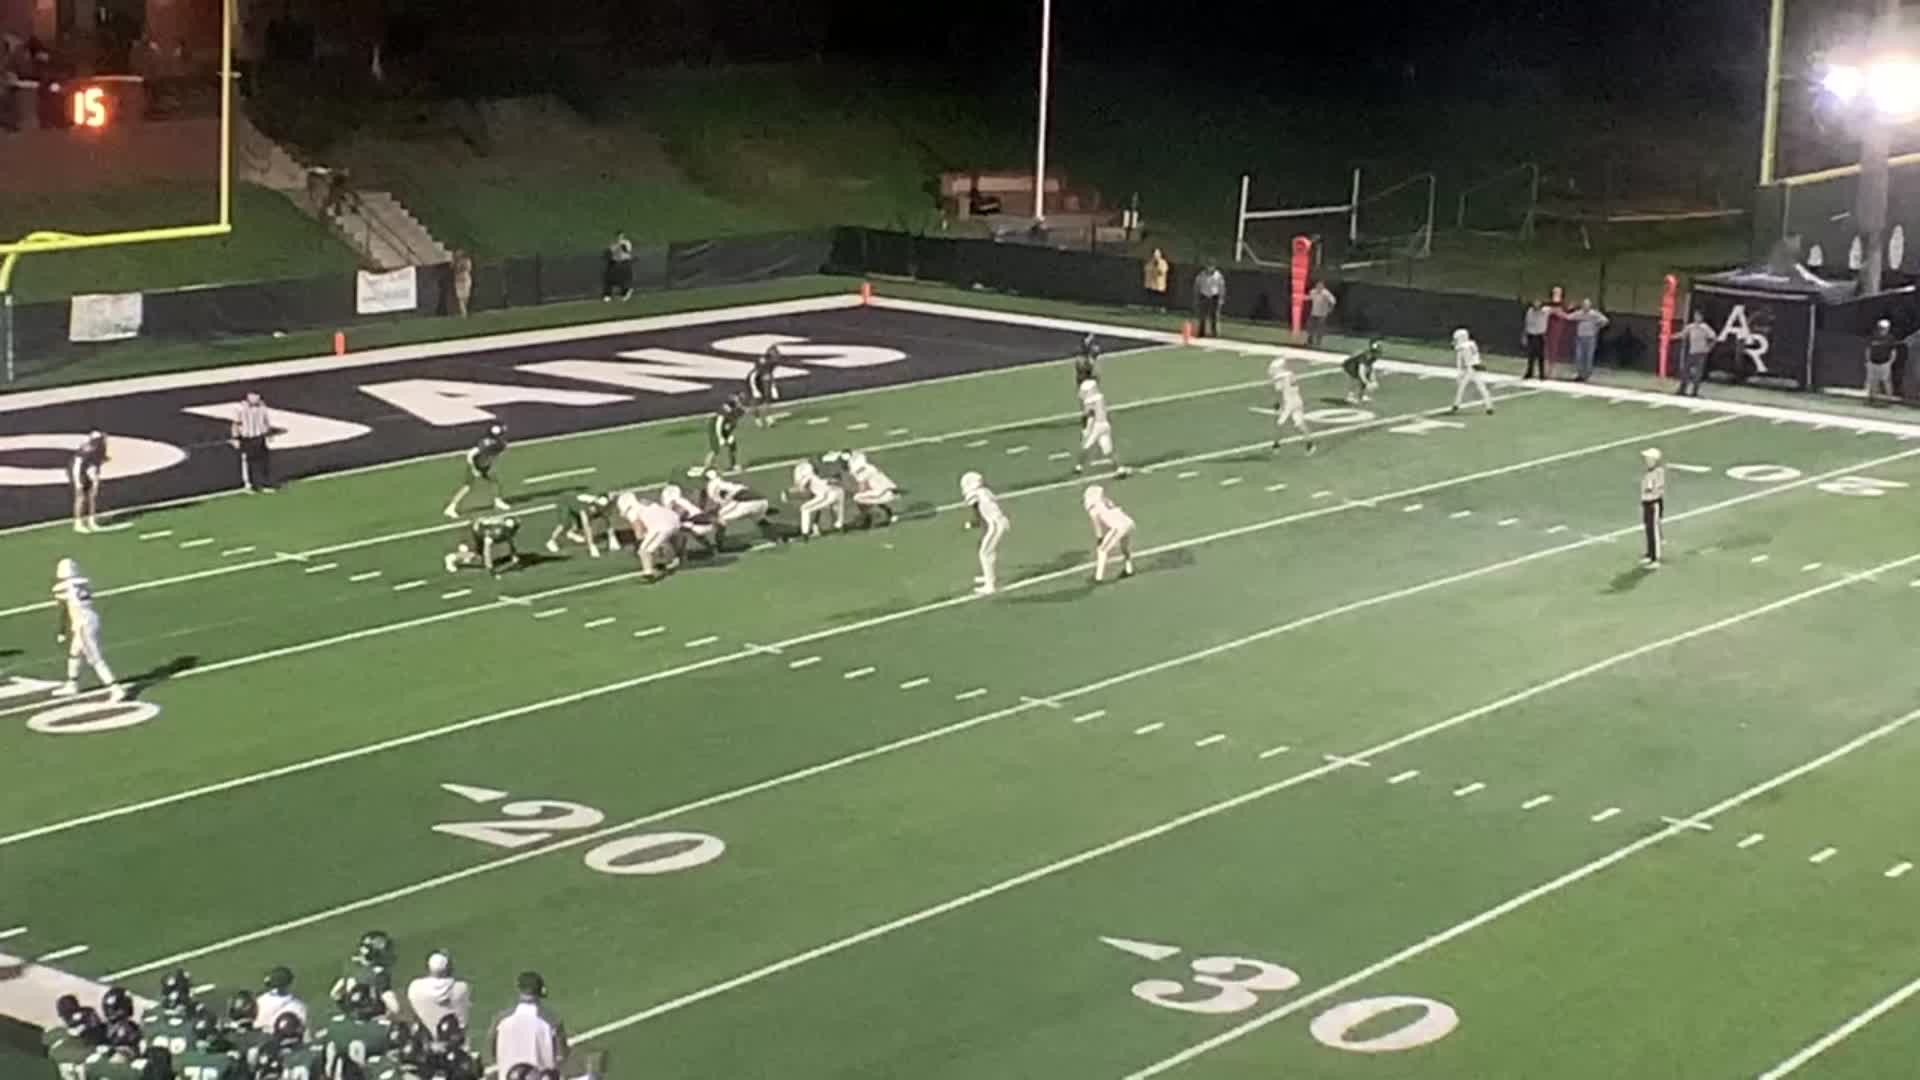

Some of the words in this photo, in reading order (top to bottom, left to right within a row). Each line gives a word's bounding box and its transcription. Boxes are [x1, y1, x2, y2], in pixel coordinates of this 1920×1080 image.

[75, 87, 105, 127] 15
[432, 800, 726, 875] 20
[1131, 956, 1460, 1053] 30
